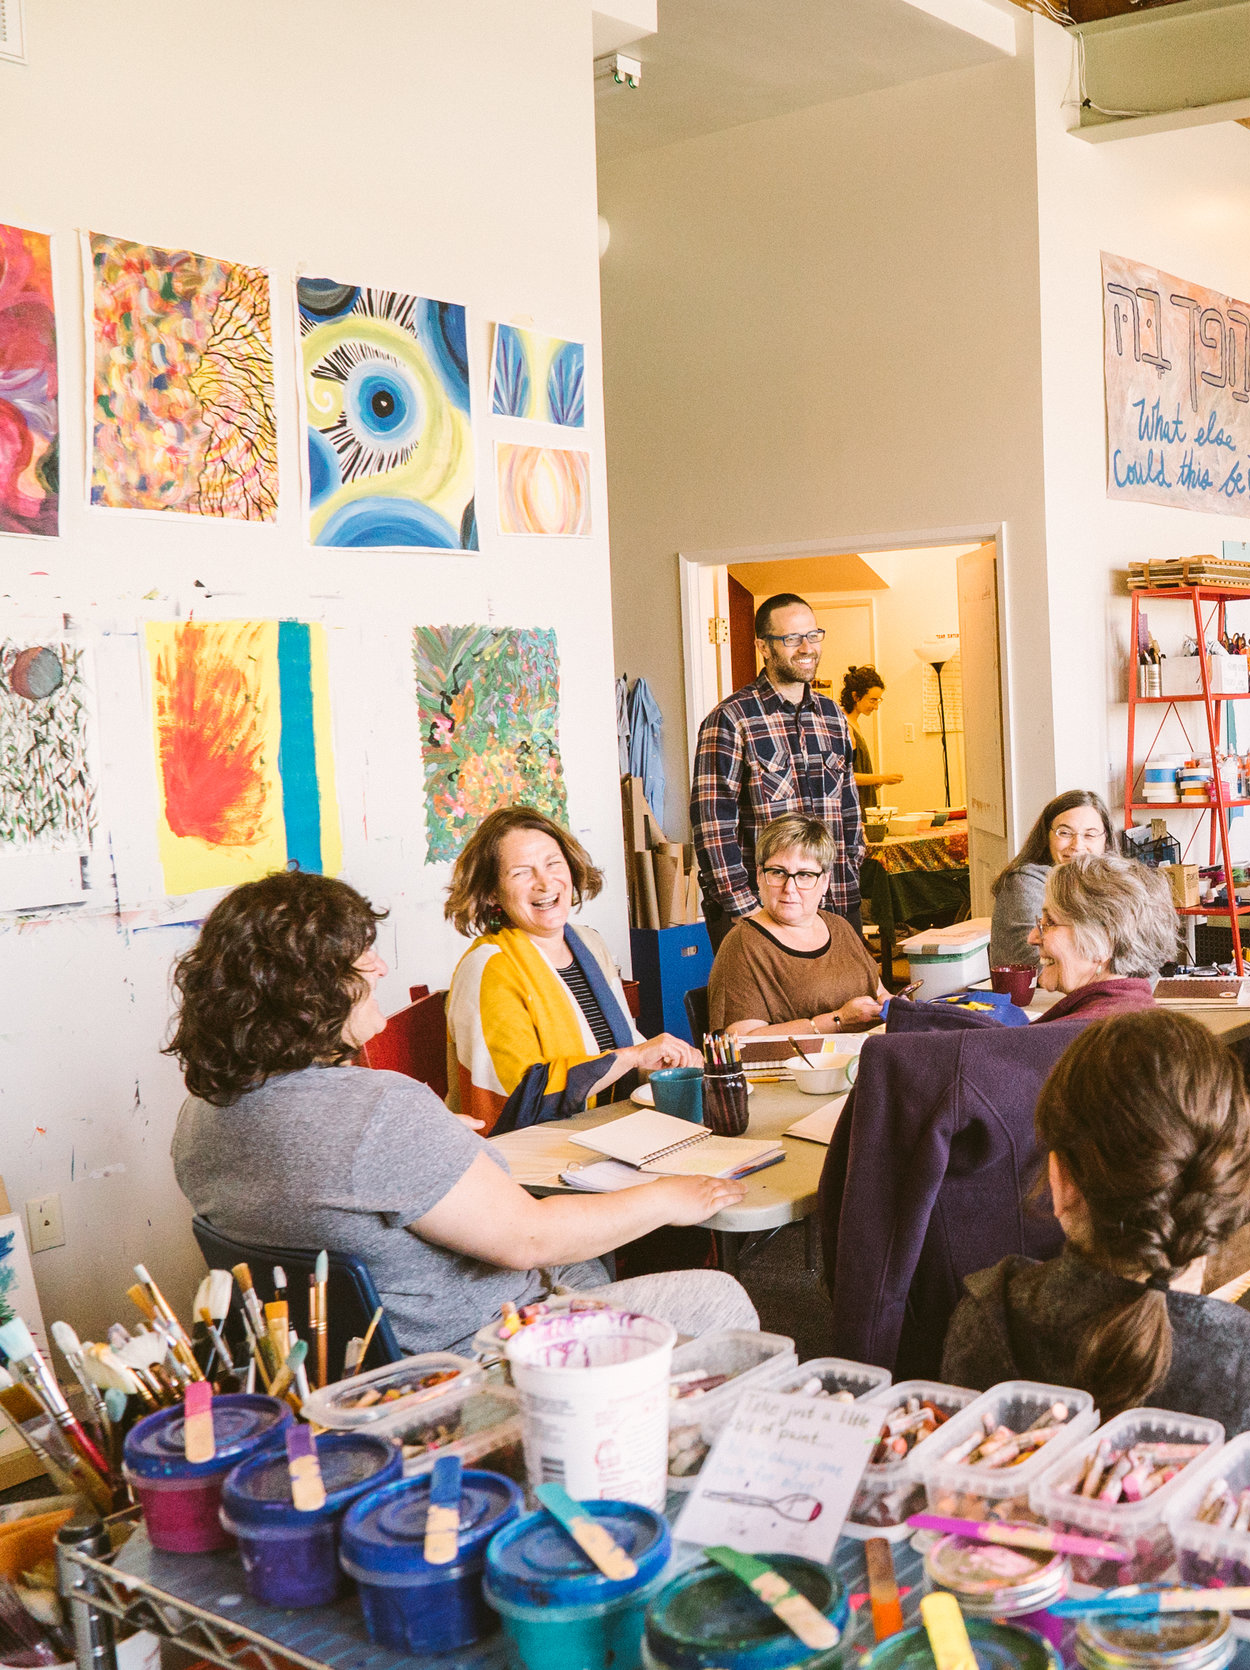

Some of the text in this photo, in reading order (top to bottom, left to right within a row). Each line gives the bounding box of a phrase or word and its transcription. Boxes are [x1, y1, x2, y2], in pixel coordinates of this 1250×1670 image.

[1133, 396, 1236, 451] What else
[1112, 449, 1173, 488] Could
[1175, 447, 1214, 491] this
